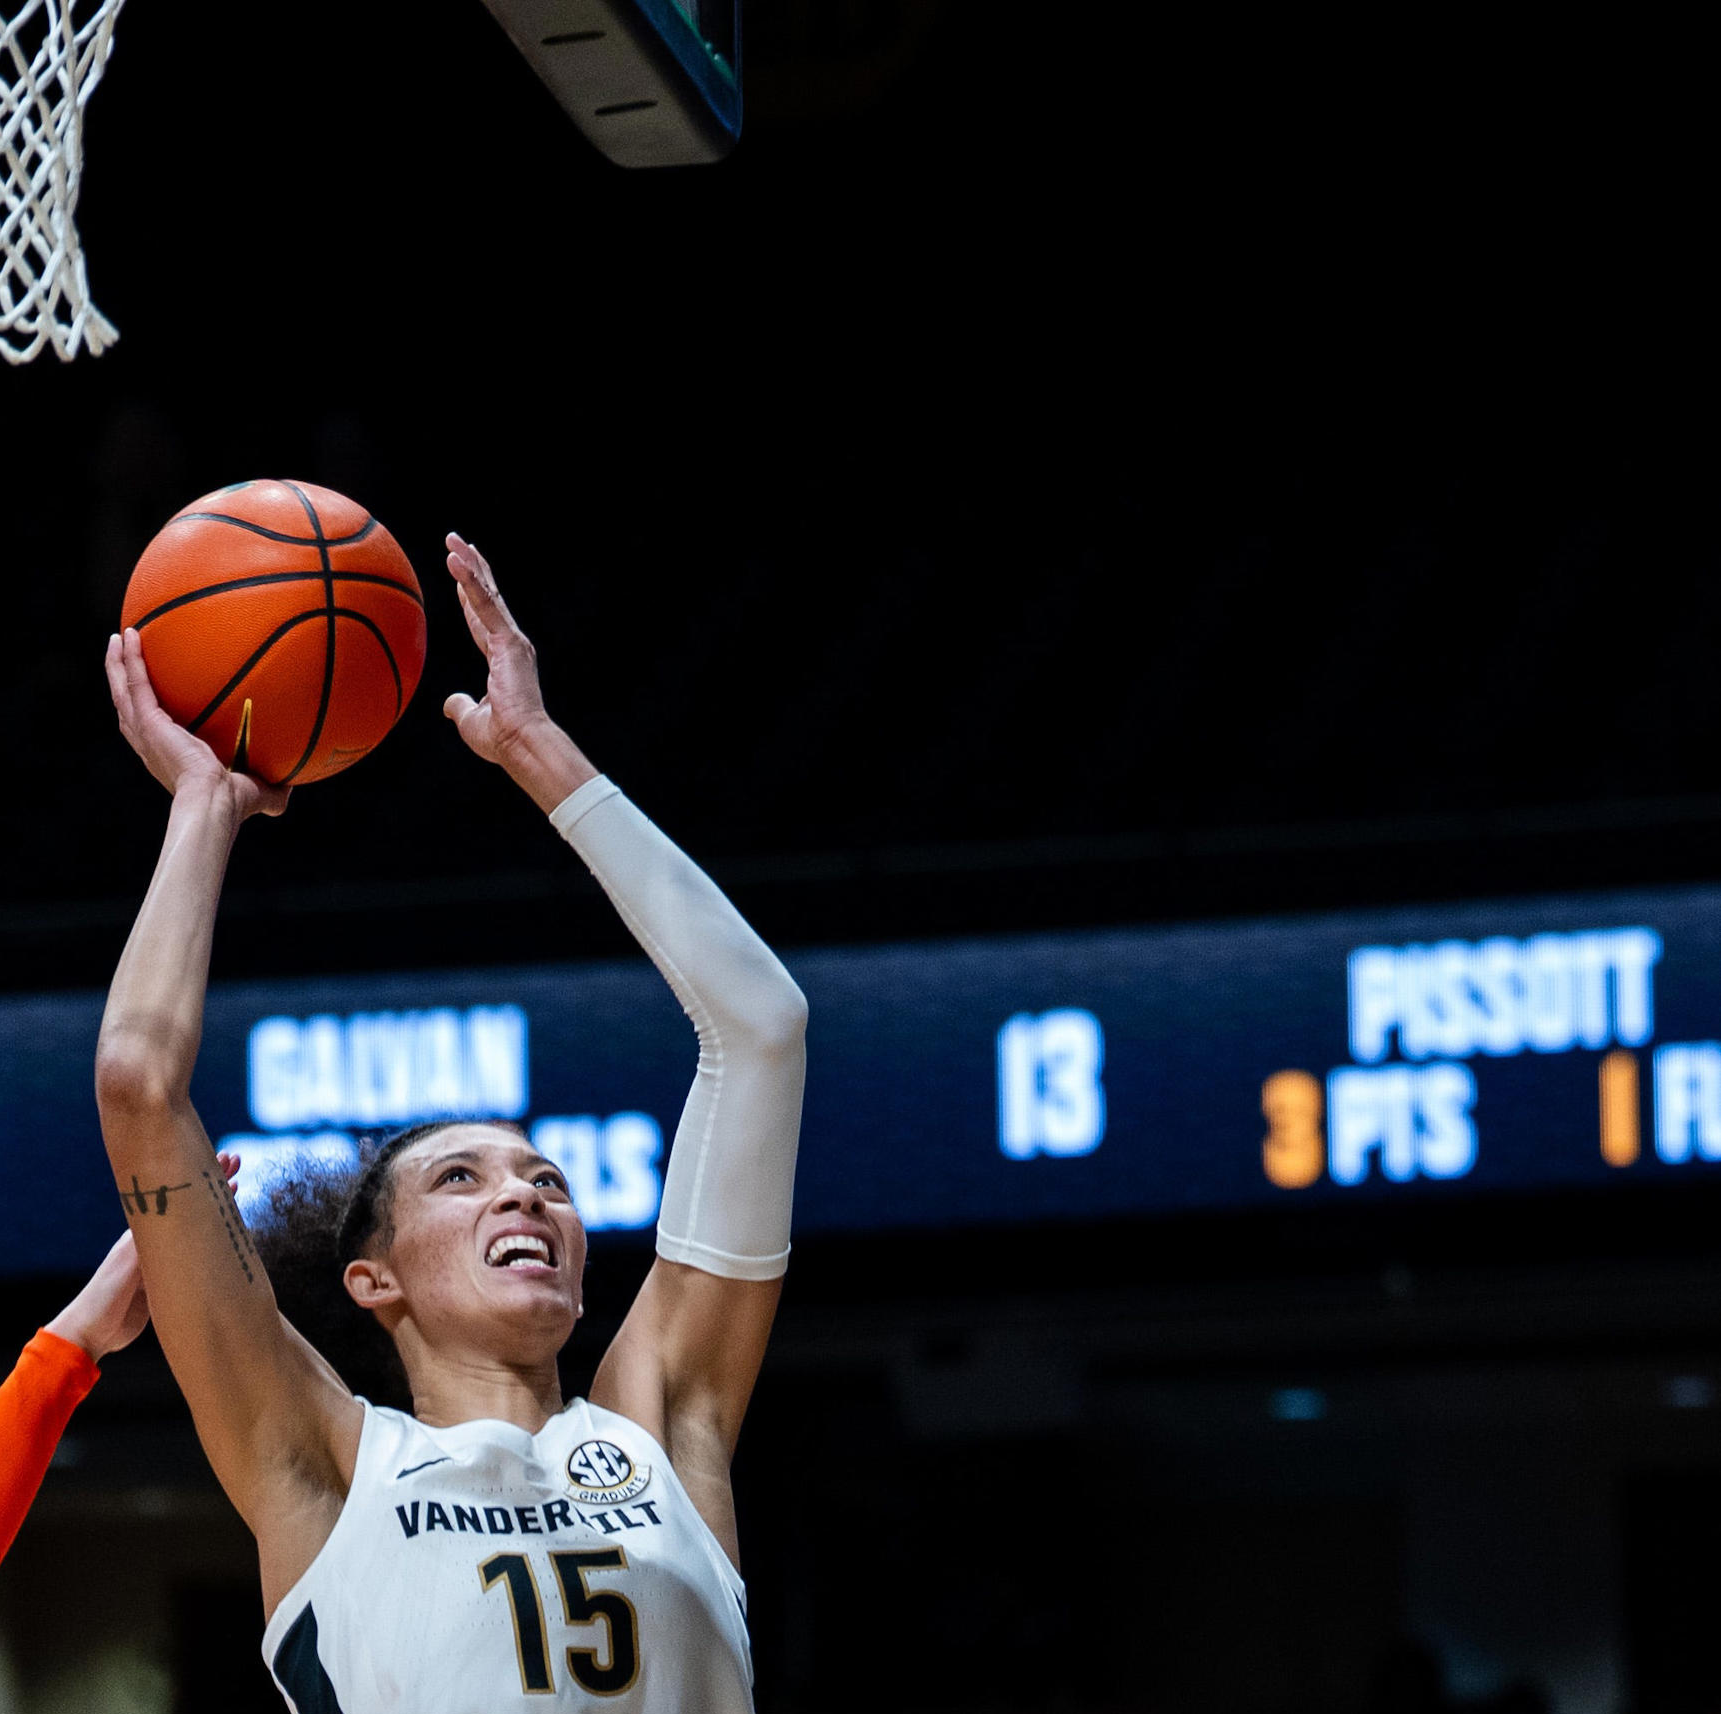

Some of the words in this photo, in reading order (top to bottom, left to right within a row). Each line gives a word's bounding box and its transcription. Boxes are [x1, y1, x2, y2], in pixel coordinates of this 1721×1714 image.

[1347, 927, 1664, 1062] PISSOTT
[247, 1004, 529, 1130] GALVAN
[996, 1008, 1106, 1160] 13
[1263, 1072, 1321, 1187] 3
[1326, 1062, 1478, 1186] PTS
[1600, 1054, 1638, 1166] 1
[396, 1499, 662, 1539] VANDERILT
[567, 1441, 631, 1488] SEC
[579, 1476, 646, 1502] GRADUATE
[478, 1545, 640, 1697] 15
